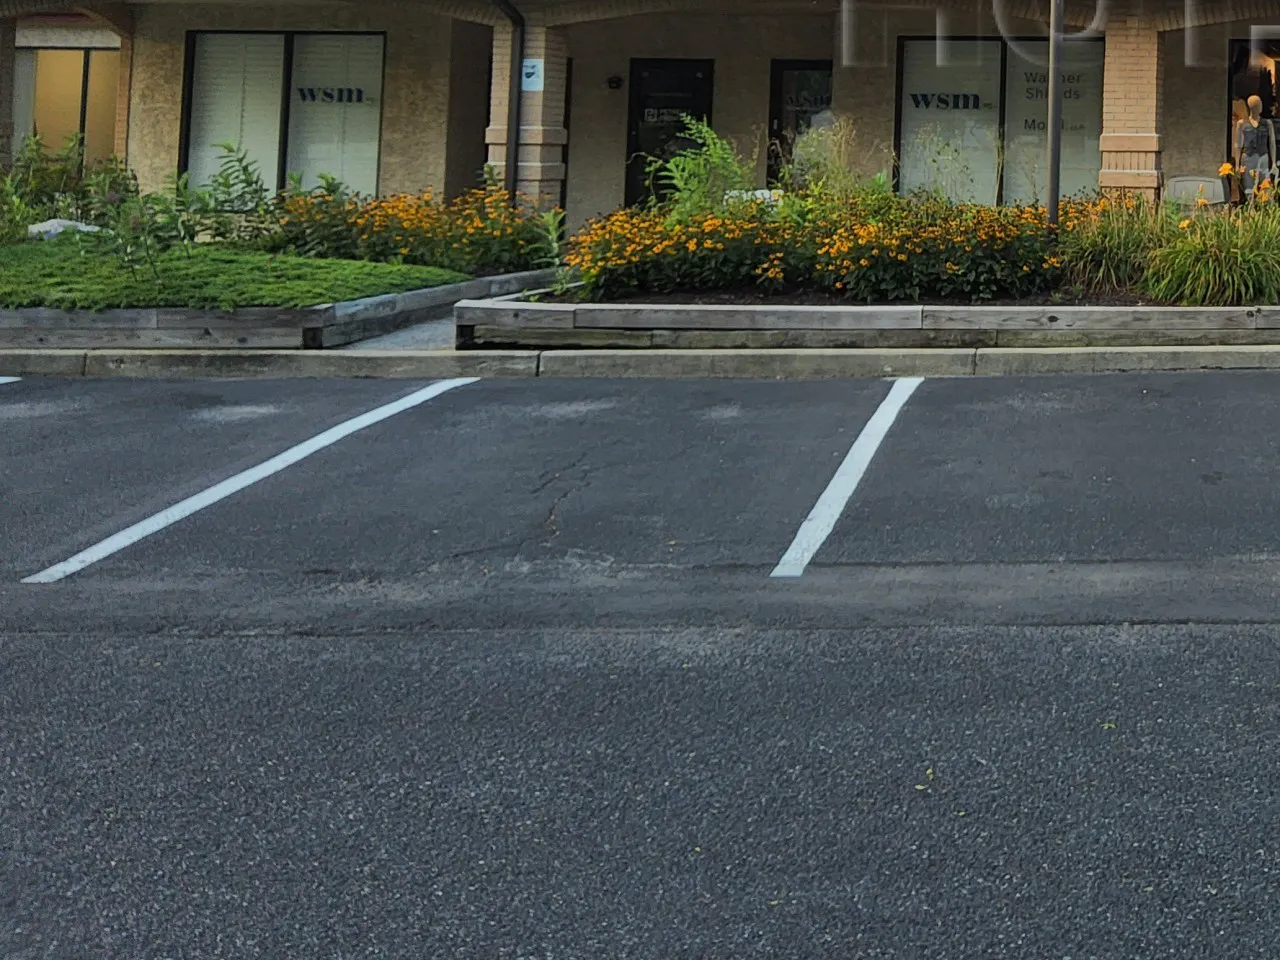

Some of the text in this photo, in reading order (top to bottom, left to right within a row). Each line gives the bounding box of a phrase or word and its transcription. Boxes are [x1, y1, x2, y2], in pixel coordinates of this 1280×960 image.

[1024, 72, 1082, 84] Waner
[1025, 87, 1080, 100] Shids
[909, 92, 980, 110] wsm
